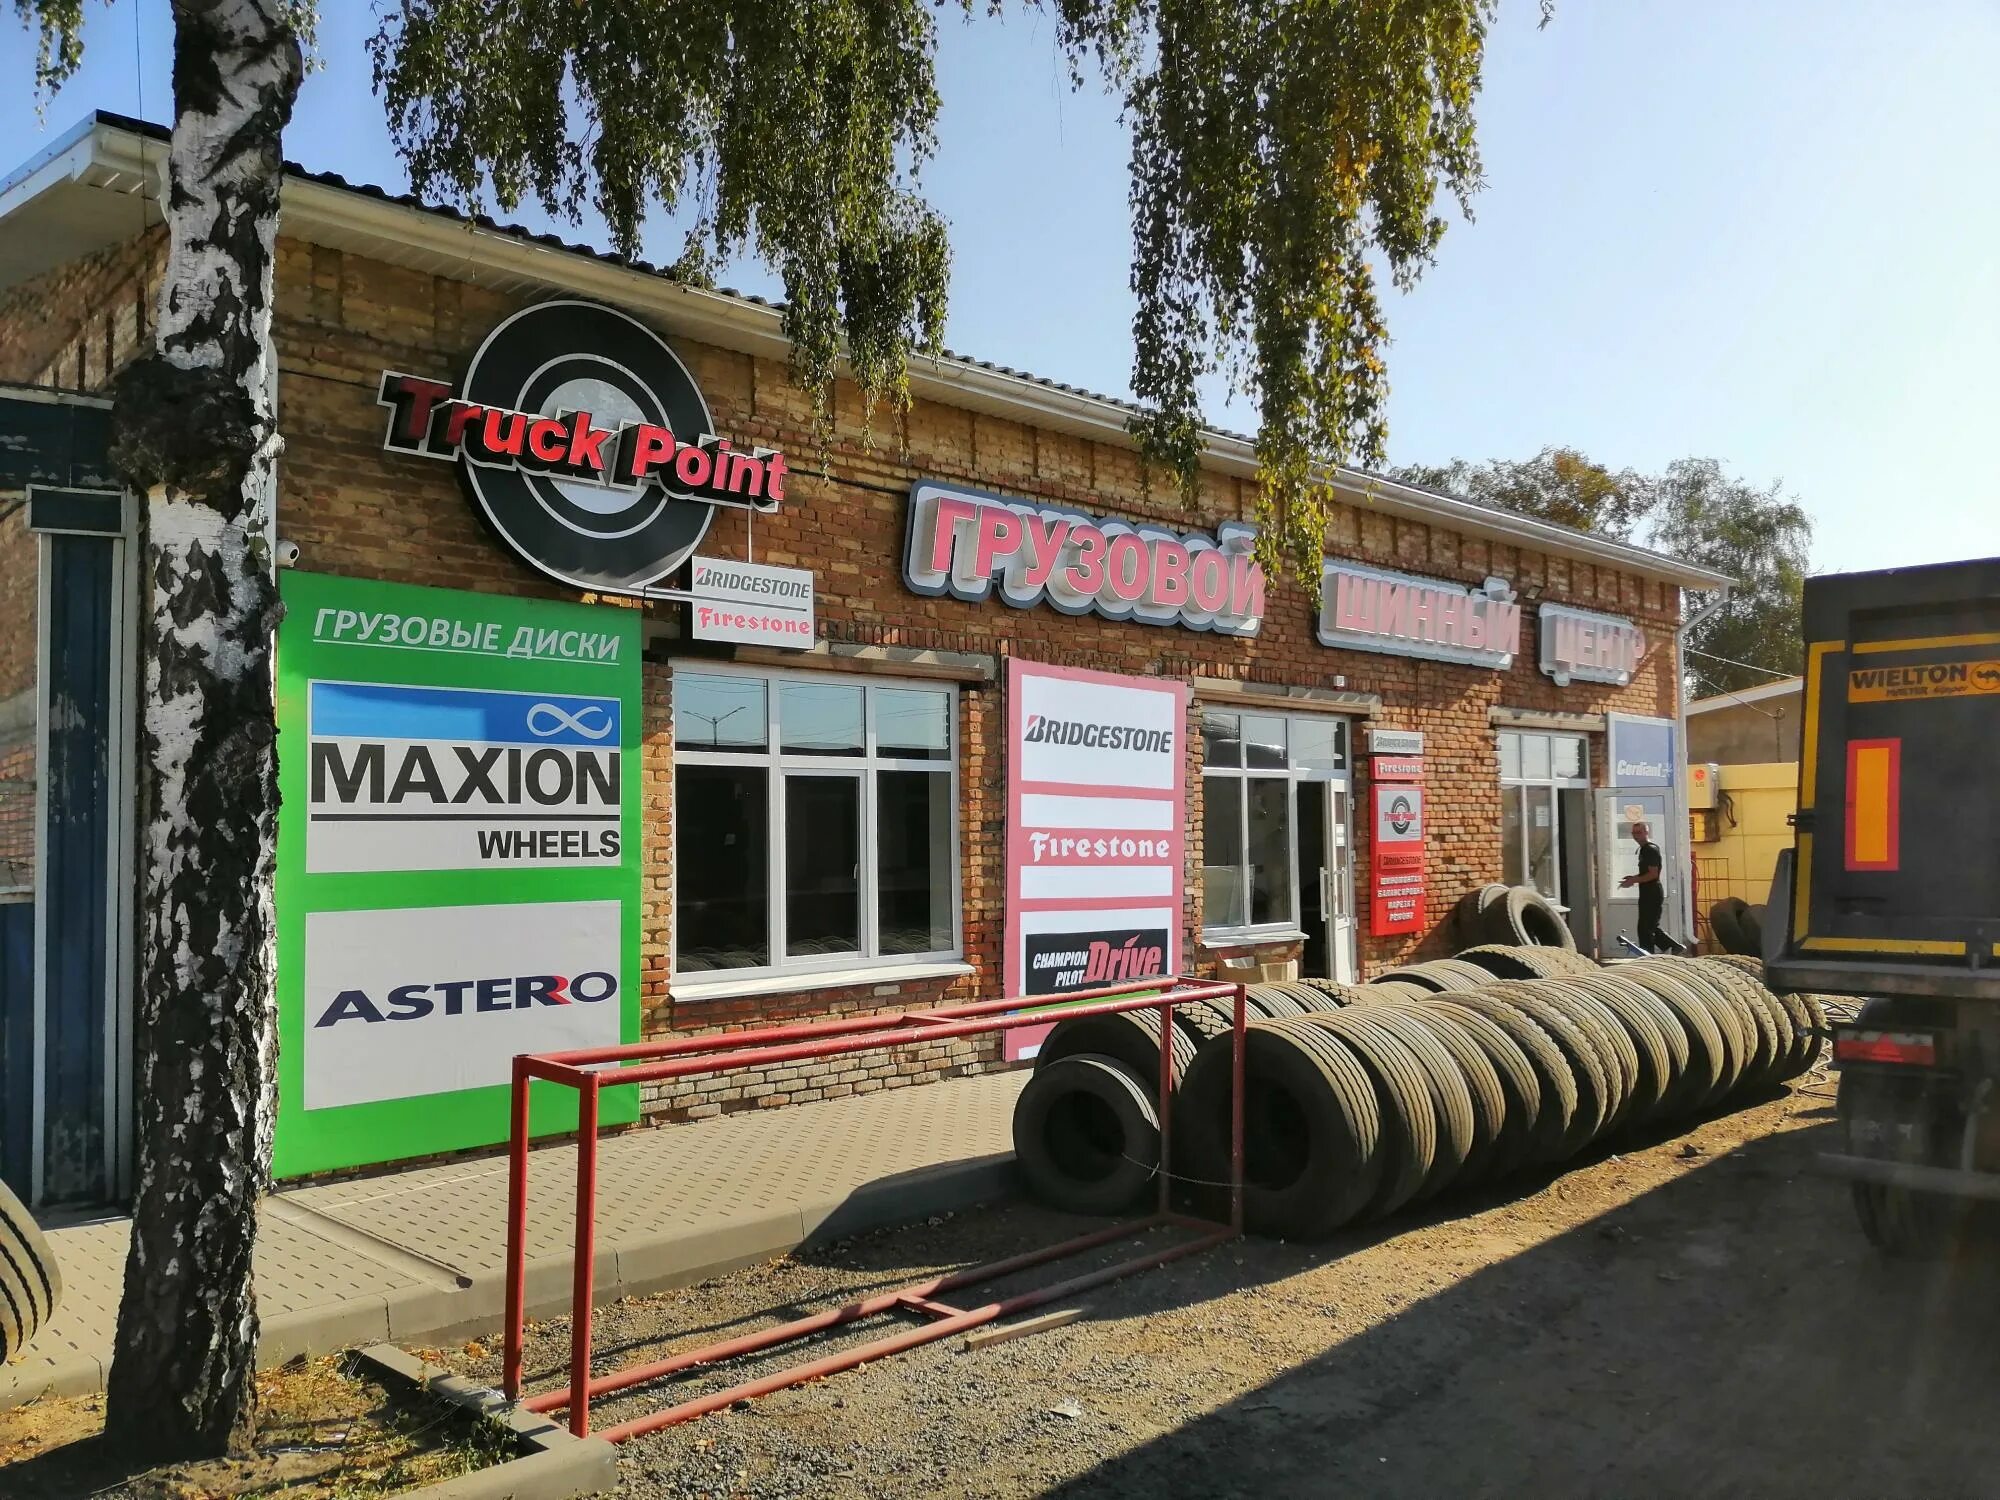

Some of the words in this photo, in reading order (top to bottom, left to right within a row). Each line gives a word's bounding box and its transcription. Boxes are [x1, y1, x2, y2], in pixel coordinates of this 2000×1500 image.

[398, 376, 612, 472] Truck
[631, 422, 790, 502] Point
[930, 496, 1265, 619] ГРУЗОВОЙ
[694, 566, 811, 600] BRIDGESTONE
[314, 608, 502, 652] ГРУЗОВЫЕ
[506, 626, 623, 660] ДИСКИ
[696, 606, 811, 636] Firestone
[1335, 572, 1521, 655] ШИННЫЙ
[1555, 614, 1646, 674] ЦЕНТР
[1851, 664, 1967, 689] WIELTON
[1023, 714, 1173, 754] BRIDGESTONE
[310, 742, 622, 805] MAXION
[1378, 762, 1423, 775] Firestone
[1617, 760, 1662, 777] Cordiant
[477, 829, 621, 859] WHEELS
[1029, 832, 1170, 863] Firestone
[1033, 951, 1088, 970] CHAMPION
[1082, 932, 1162, 984] Drive
[1055, 969, 1084, 987] PILOT
